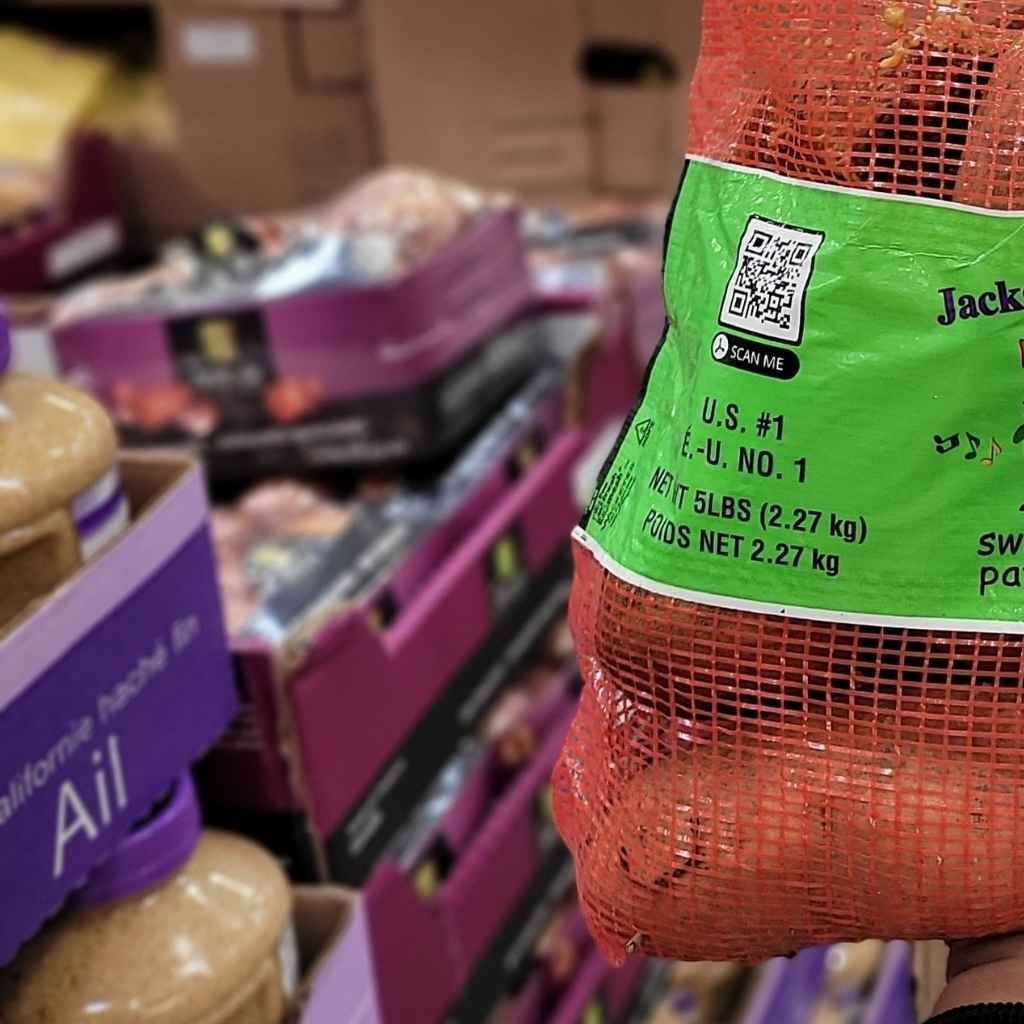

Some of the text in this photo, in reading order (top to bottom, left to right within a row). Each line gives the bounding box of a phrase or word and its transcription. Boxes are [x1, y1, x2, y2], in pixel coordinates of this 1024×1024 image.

[730, 345, 785, 371] SCAN ME
[702, 397, 784, 441] U.S. #1
[738, 446, 783, 480] NO.
[794, 457, 806, 483] 1
[648, 466, 674, 498] NET
[693, 489, 751, 522] 5LBS
[759, 502, 822, 534] (2.27
[830, 513, 867, 544] kg)
[642, 509, 839, 576] POIDS NET 2.27 kg
[0, 716, 94, 825] alifornie
[53, 736, 128, 878] Ail
